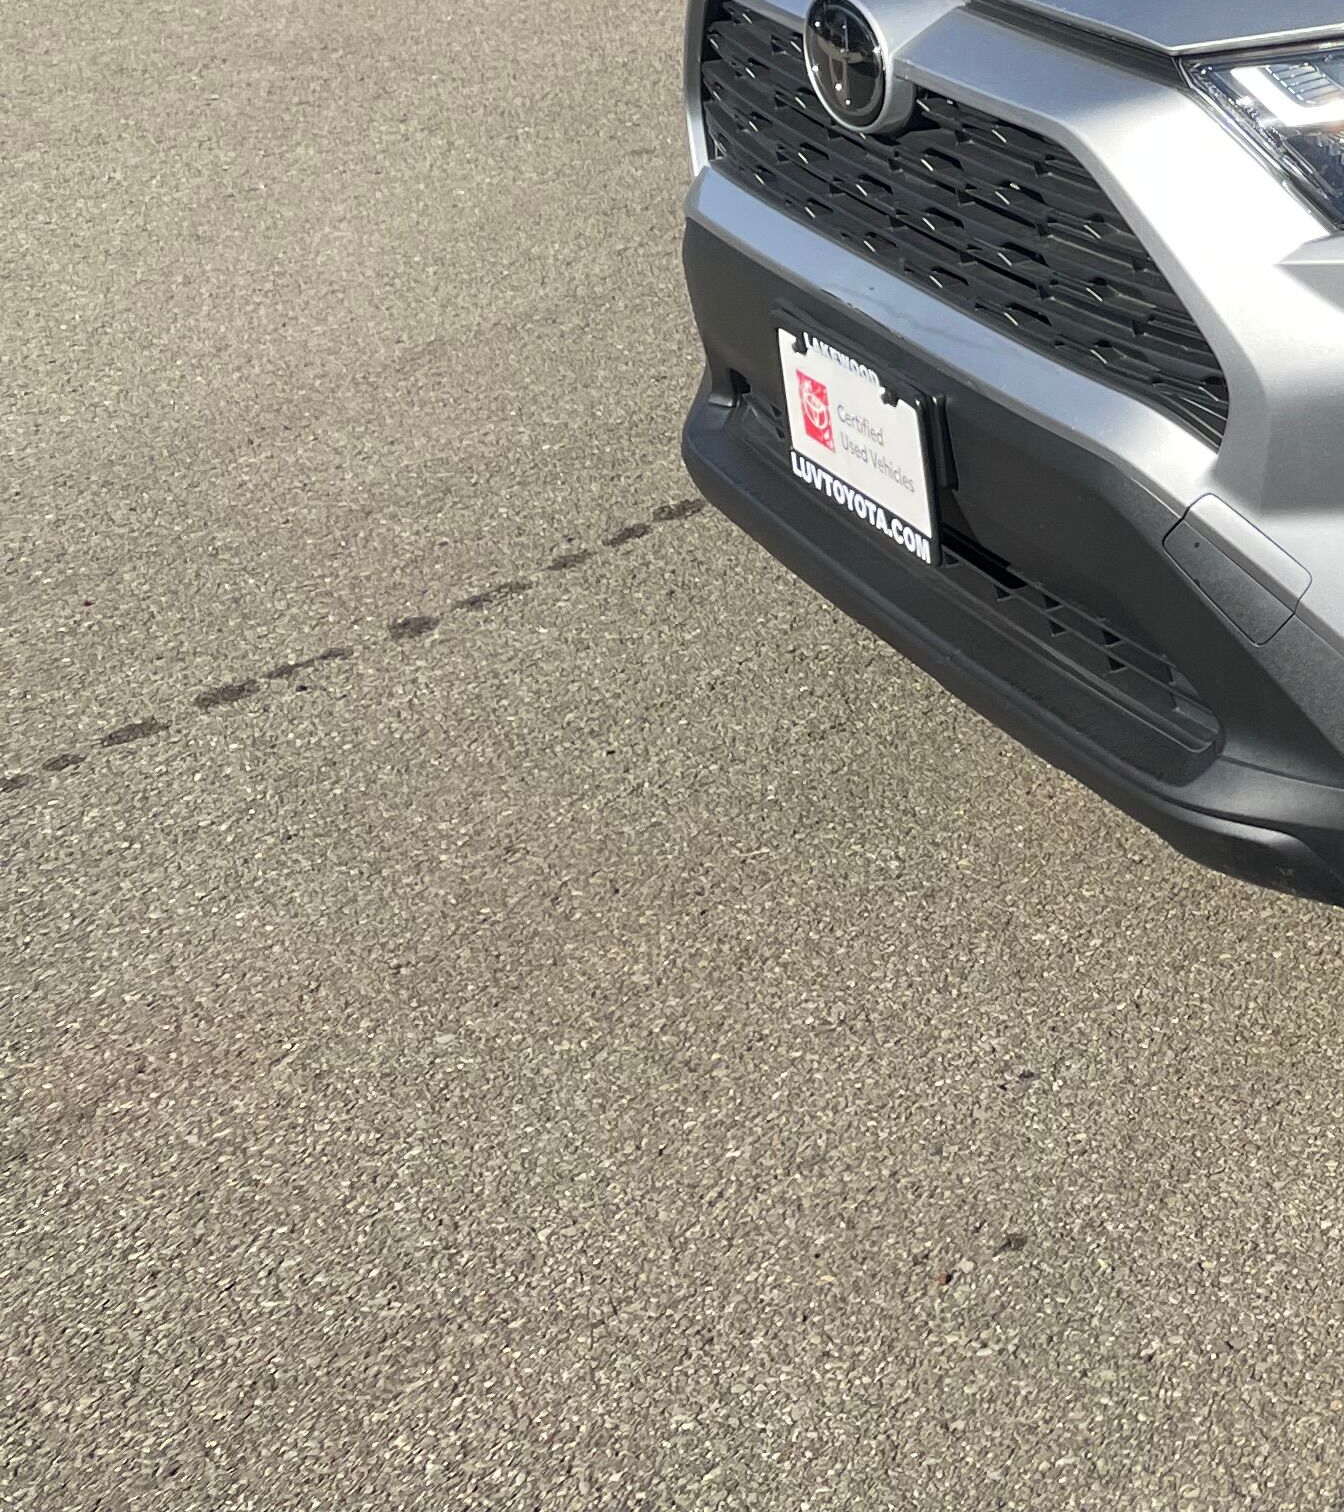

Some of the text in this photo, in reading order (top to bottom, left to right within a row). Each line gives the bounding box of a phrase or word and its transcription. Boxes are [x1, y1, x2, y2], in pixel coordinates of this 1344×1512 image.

[803, 332, 880, 386] LAKEWOOD
[837, 404, 884, 445] Certified
[839, 431, 915, 492] Used Vehicles
[791, 451, 931, 564] LUVTOYOTA.COM
